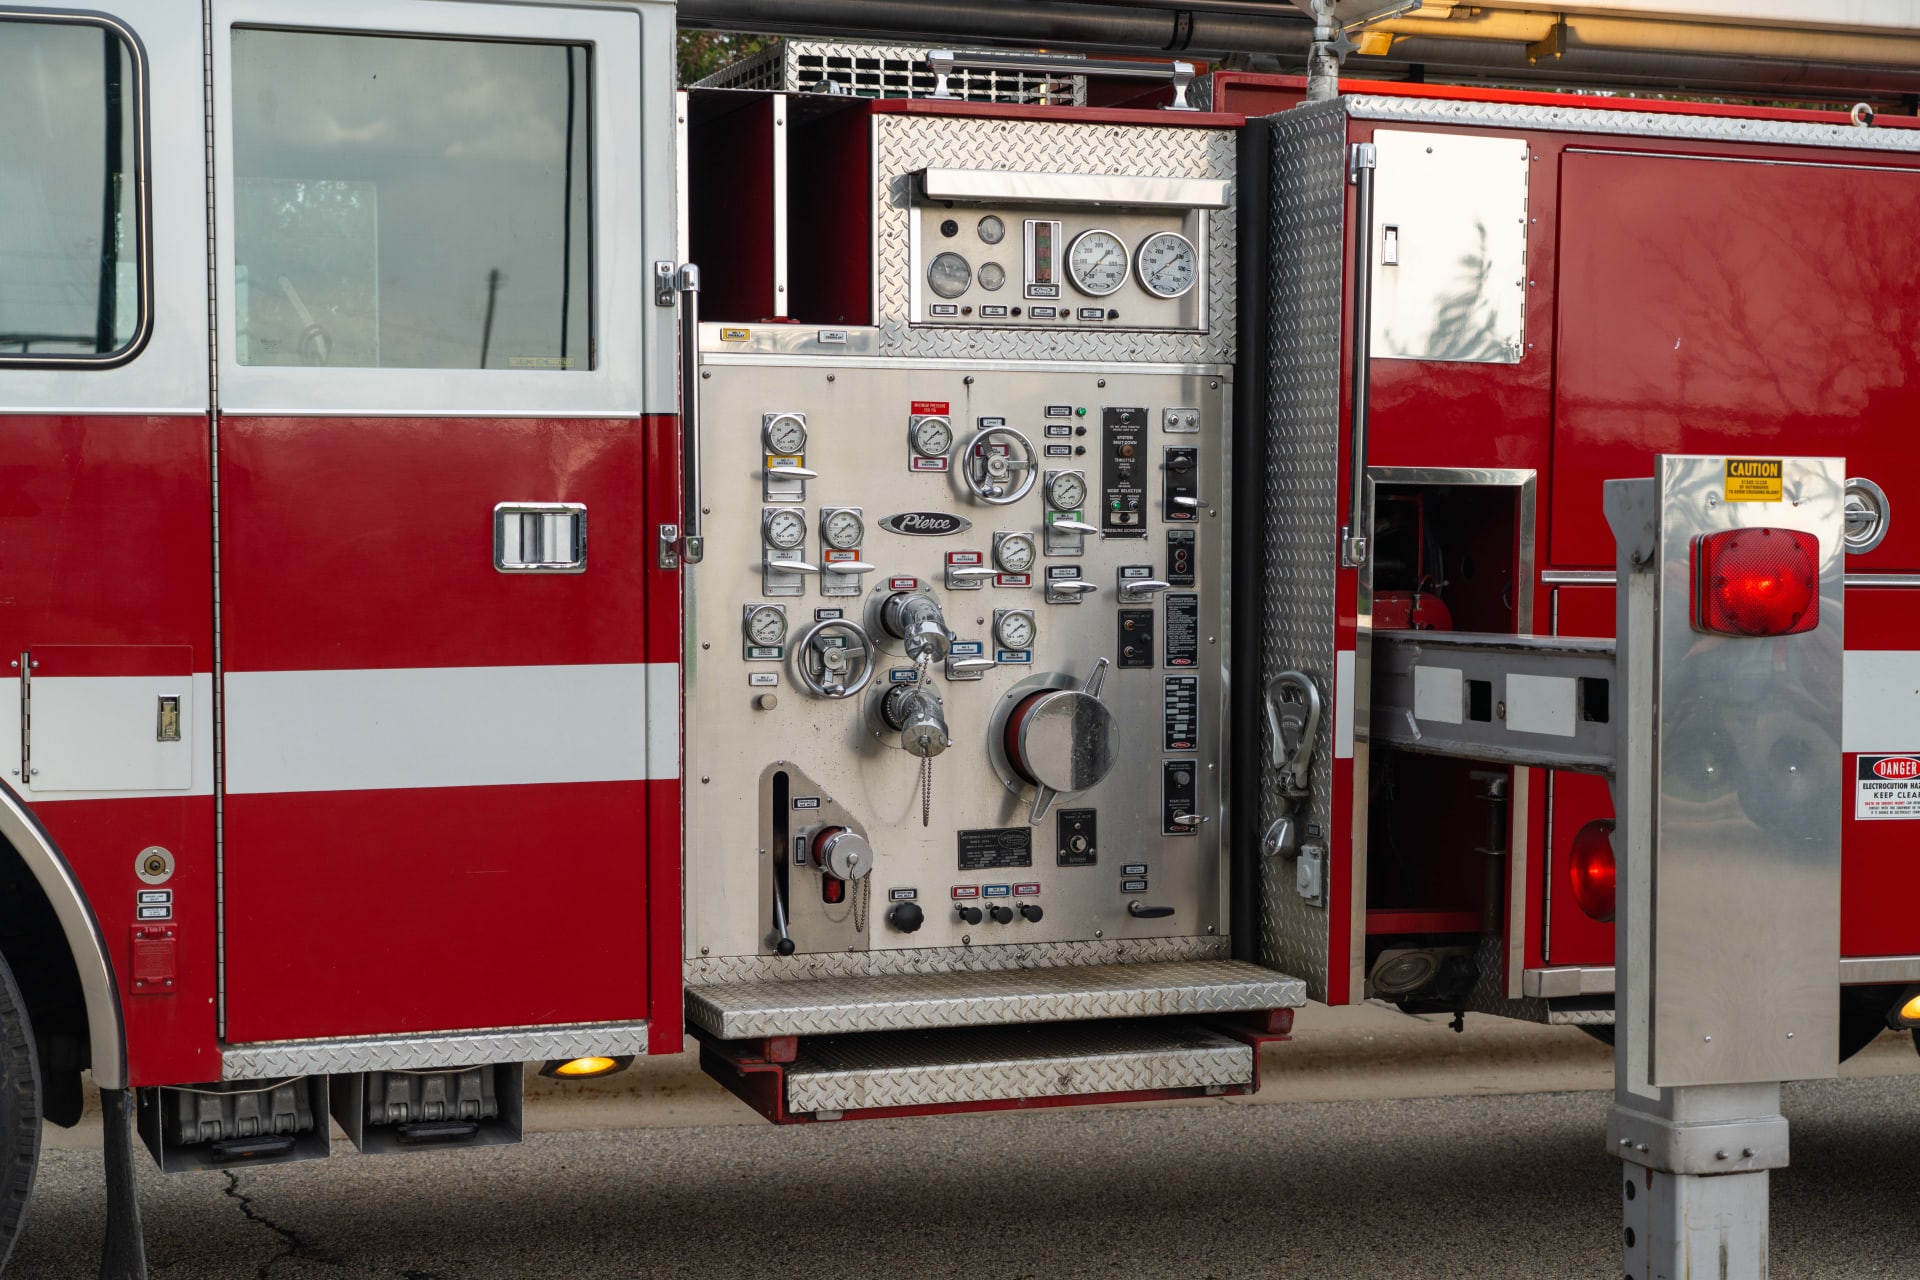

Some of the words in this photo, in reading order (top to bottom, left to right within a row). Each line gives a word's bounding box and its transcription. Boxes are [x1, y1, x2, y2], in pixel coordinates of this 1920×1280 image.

[1730, 462, 1778, 476] CAUTION
[900, 514, 950, 531] Pierce
[1880, 762, 1916, 775] DANGER
